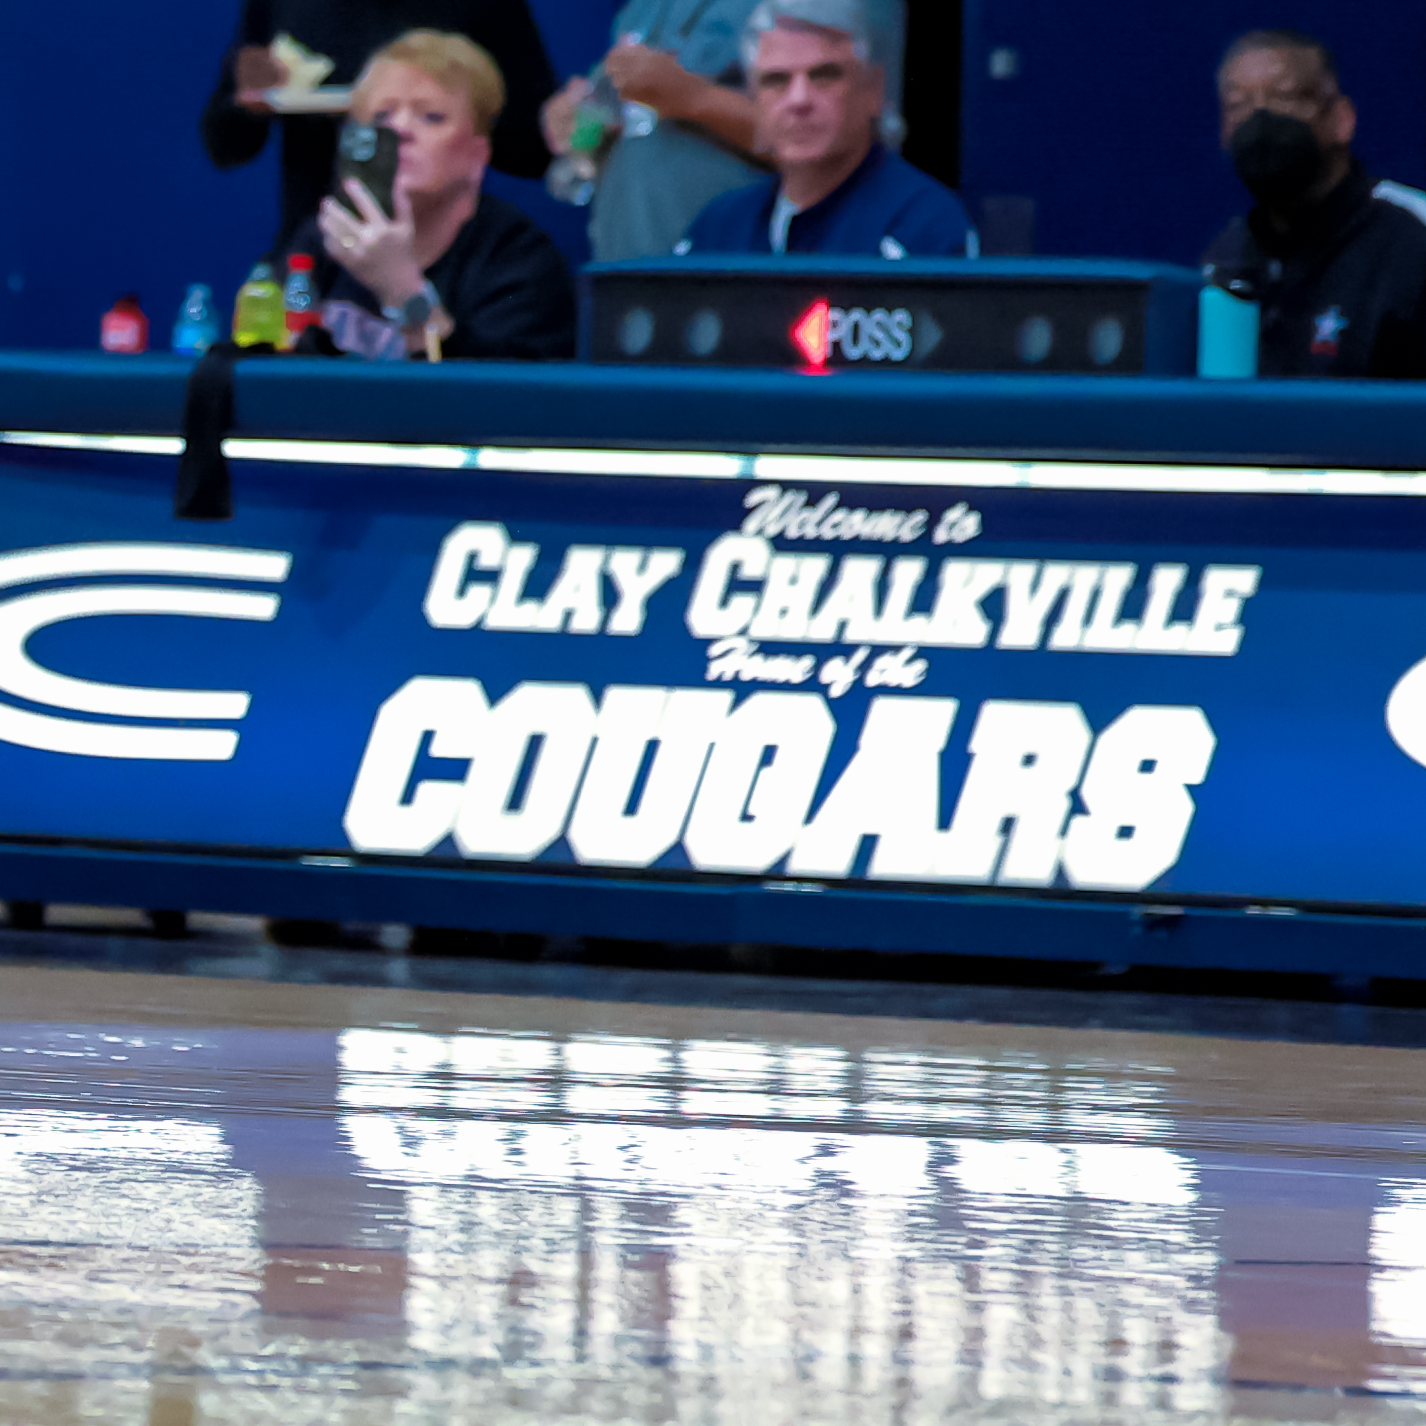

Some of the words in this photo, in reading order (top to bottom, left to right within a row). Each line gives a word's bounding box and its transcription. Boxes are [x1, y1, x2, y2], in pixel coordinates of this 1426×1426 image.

[827, 306, 913, 362] POSS
[741, 485, 929, 543] Welcome
[932, 502, 982, 546] to
[423, 520, 686, 637] CLAY
[684, 533, 1262, 657] CHALKVILLE
[706, 639, 815, 685] Home
[818, 647, 870, 698] of
[864, 645, 928, 688] the
[342, 675, 1218, 893] COUGARS
